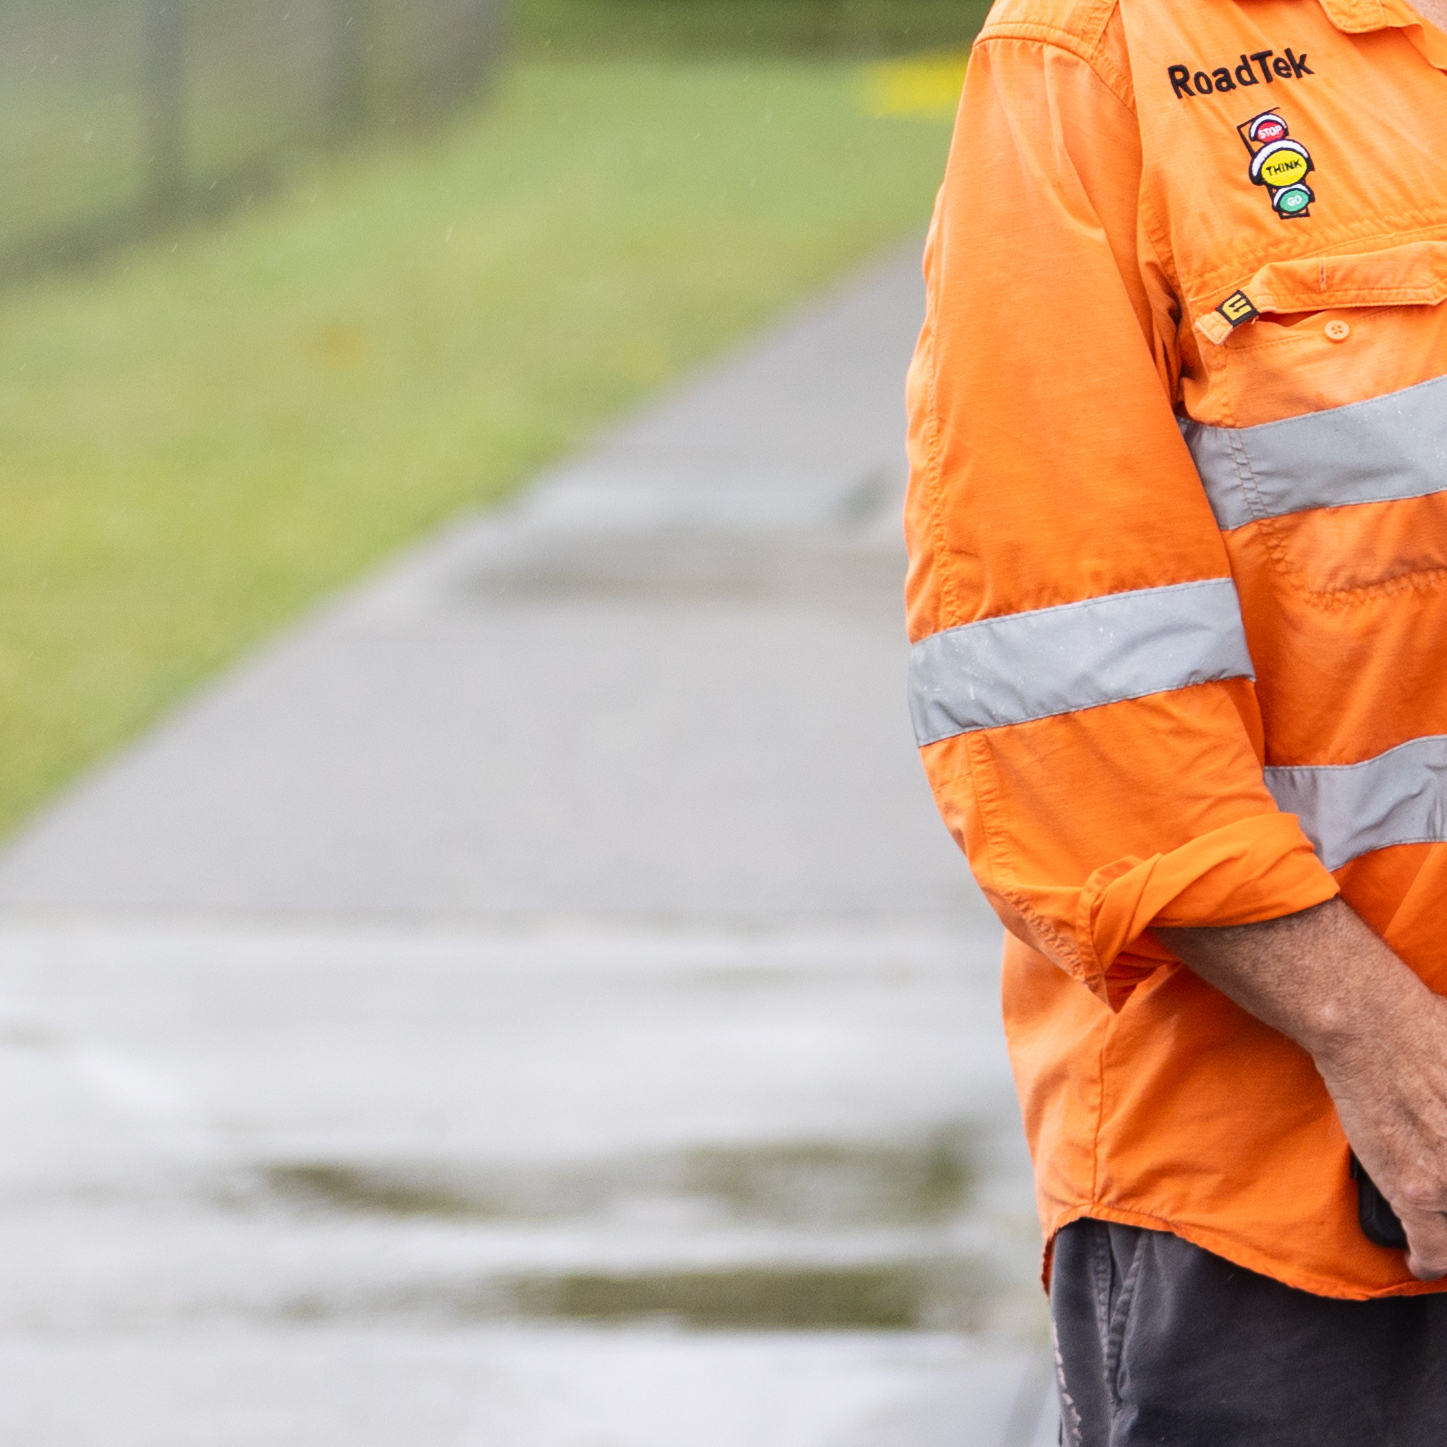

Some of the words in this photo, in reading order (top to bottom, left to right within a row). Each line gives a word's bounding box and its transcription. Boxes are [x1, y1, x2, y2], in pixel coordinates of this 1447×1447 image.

[1168, 48, 1315, 99] RoadTek
[1257, 125, 1283, 139] STOP
[1265, 158, 1303, 176] THINK
[1286, 194, 1303, 207] GO
